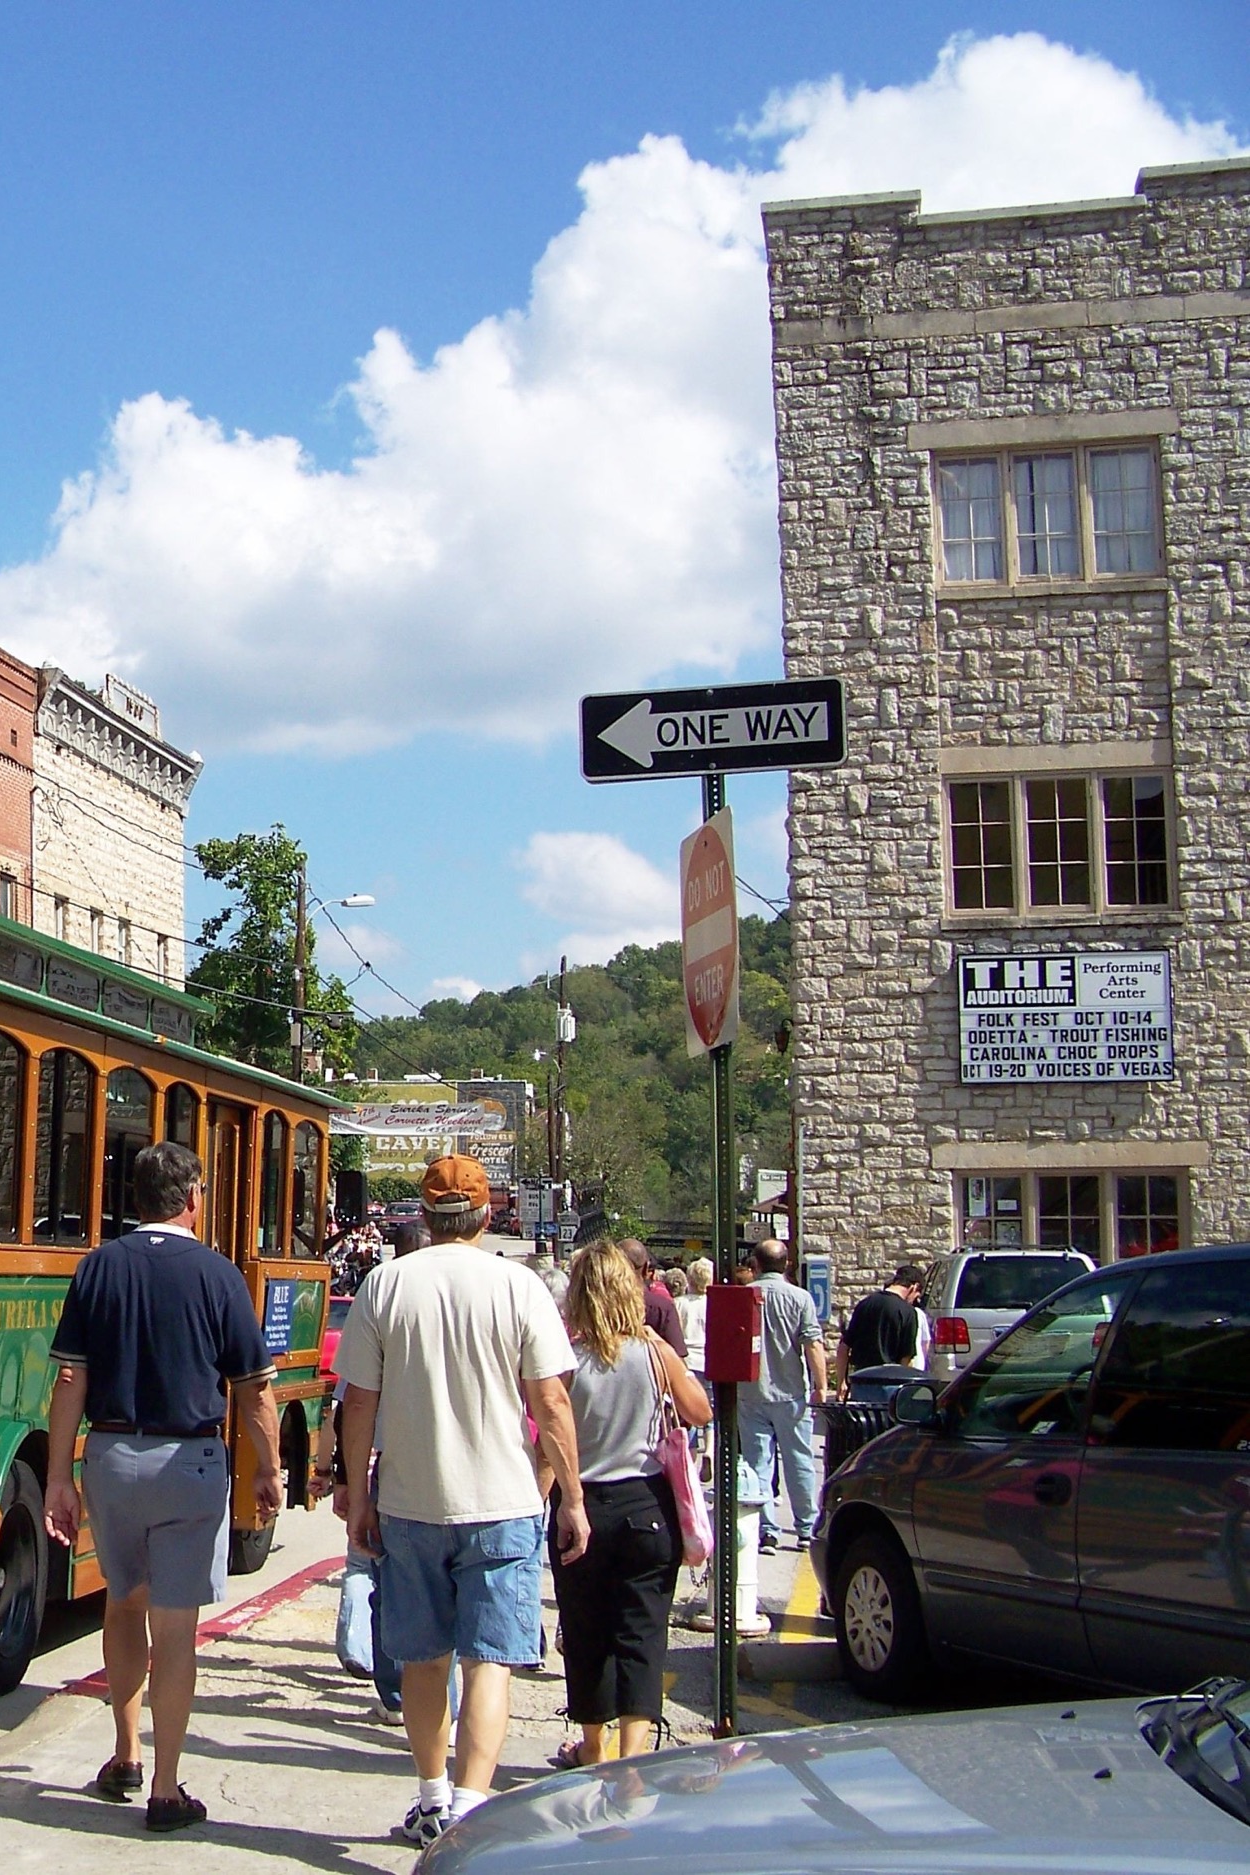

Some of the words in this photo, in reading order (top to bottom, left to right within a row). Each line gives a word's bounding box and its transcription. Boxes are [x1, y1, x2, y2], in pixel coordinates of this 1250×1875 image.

[656, 713, 731, 748] ONE
[744, 705, 820, 742] WAY
[688, 878, 701, 912] DO
[705, 860, 726, 900] NOT
[966, 959, 1074, 989] THE
[1082, 961, 1162, 977] Performing
[693, 963, 725, 1007] ENTER
[1107, 975, 1139, 986] Arts
[1099, 987, 1146, 999] Center
[977, 1012, 1015, 1028] FOLK
[1022, 1011, 1060, 1027] FEST
[1074, 1011, 1105, 1026] OCT
[1112, 1010, 1153, 1025] 10-14
[967, 1029, 1028, 1045] ODETTA
[1049, 1028, 1100, 1044] TROUT
[1105, 1027, 1168, 1042] FISHING
[969, 1046, 1048, 1062] CAROLINA
[1057, 1045, 1098, 1060] CHOC
[1107, 1044, 1159, 1059] DROPS
[962, 1064, 981, 1079] OCT
[988, 1063, 1027, 1078] 19-20
[1036, 1062, 1092, 1077] VOICES
[1096, 1062, 1115, 1076] OF
[1121, 1061, 1173, 1076] VEGAS
[390, 1104, 430, 1114] Eureka
[435, 1104, 478, 1117] Springs
[384, 1115, 430, 1126] Corvette
[434, 1115, 484, 1126] Weekend
[375, 1136, 441, 1150] CAVE
[469, 1143, 515, 1157] Crescent
[562, 1228, 573, 1239] 23
